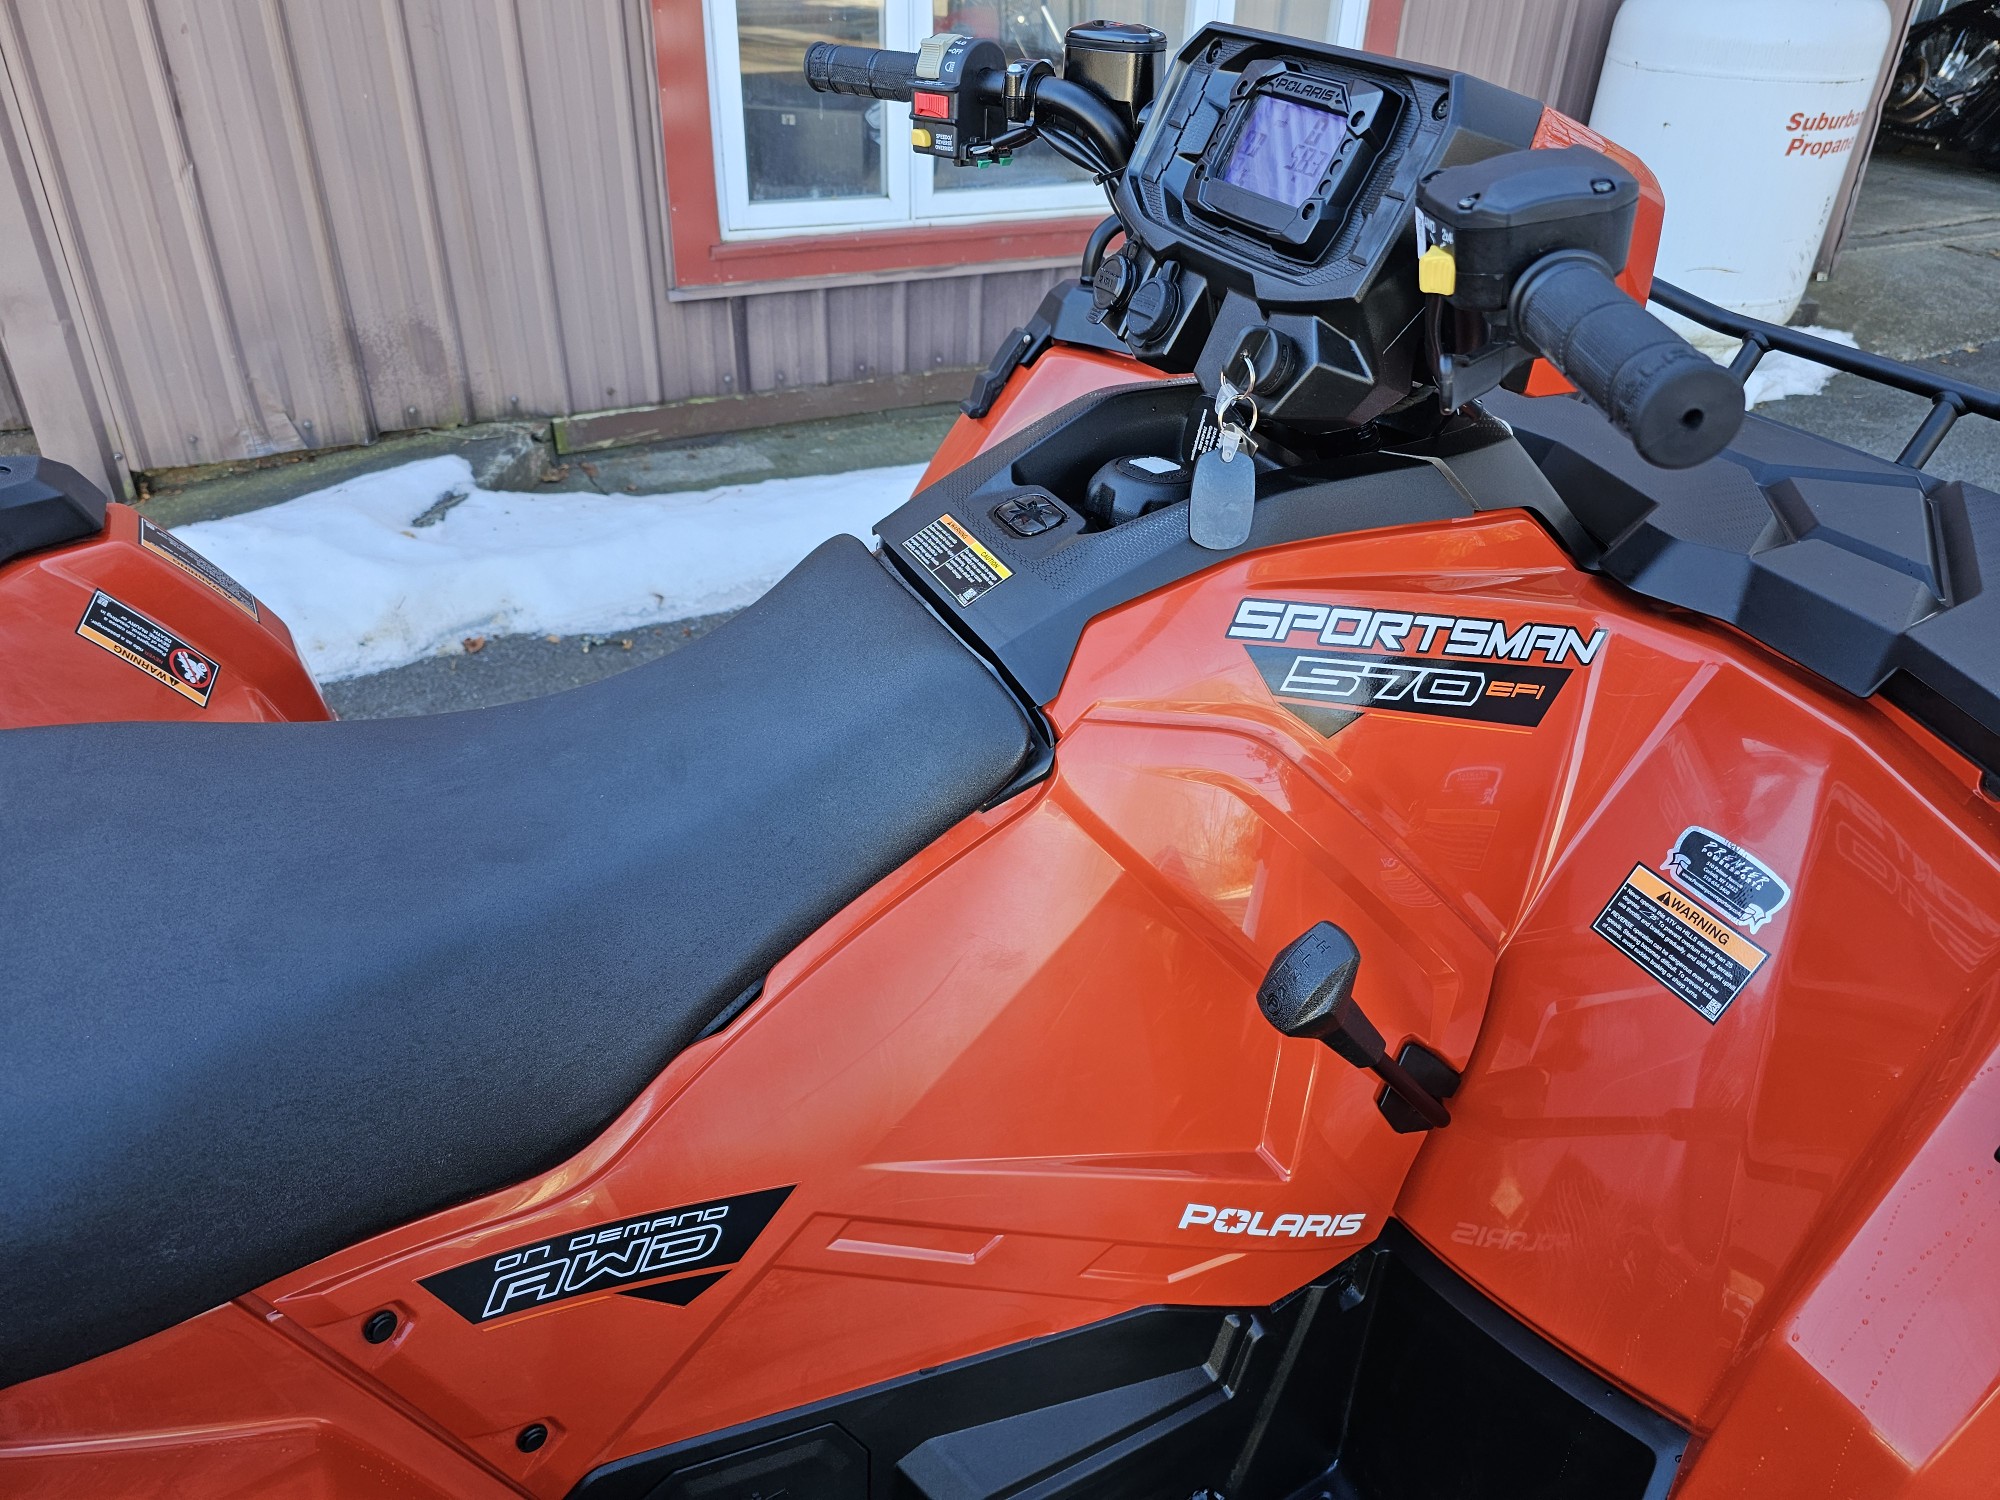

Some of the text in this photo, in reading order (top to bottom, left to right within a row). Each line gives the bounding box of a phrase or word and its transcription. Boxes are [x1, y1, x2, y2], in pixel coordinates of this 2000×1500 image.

[1276, 78, 1336, 101] POLARIS
[980, 551, 999, 568] CAUTION
[1226, 598, 1609, 667] SPORTSMAN
[113, 644, 166, 680] WARNING
[1280, 655, 1547, 707] 570 EFI
[1701, 847, 1761, 890] POWERSPORTS
[1626, 888, 1640, 900] Never
[1639, 898, 1657, 912] operate
[1664, 916, 1677, 926] ATV
[1681, 928, 1697, 942] HILLS
[1696, 940, 1715, 954] steeper
[1640, 918, 1651, 927] and
[1649, 923, 1665, 938] brakes
[1686, 952, 1697, 961] and
[1670, 897, 1729, 945] WARNING
[1610, 909, 1634, 929] REVERSE
[1632, 927, 1653, 944] operation
[1652, 942, 1662, 951] can
[1661, 948, 1668, 956] be
[1668, 954, 1692, 974] dangerous
[1691, 972, 1704, 983] even
[1708, 984, 1719, 994] low
[1621, 938, 1635, 949] avoid
[1649, 958, 1667, 975] braking
[1671, 976, 1685, 988] sharp
[1622, 928, 1641, 945] Steering
[1640, 941, 1660, 959] becomes
[1660, 958, 1677, 973] difficult.
[1678, 970, 1684, 978] To
[1683, 976, 1702, 992] prevent
[1662, 926, 1682, 940] prevent
[1680, 938, 1700, 954] overturn
[1706, 956, 1717, 967] hilly
[568, 1205, 729, 1251] DEMAND
[1177, 1203, 1366, 1238] POLARIS
[481, 1223, 722, 1319] AWD
